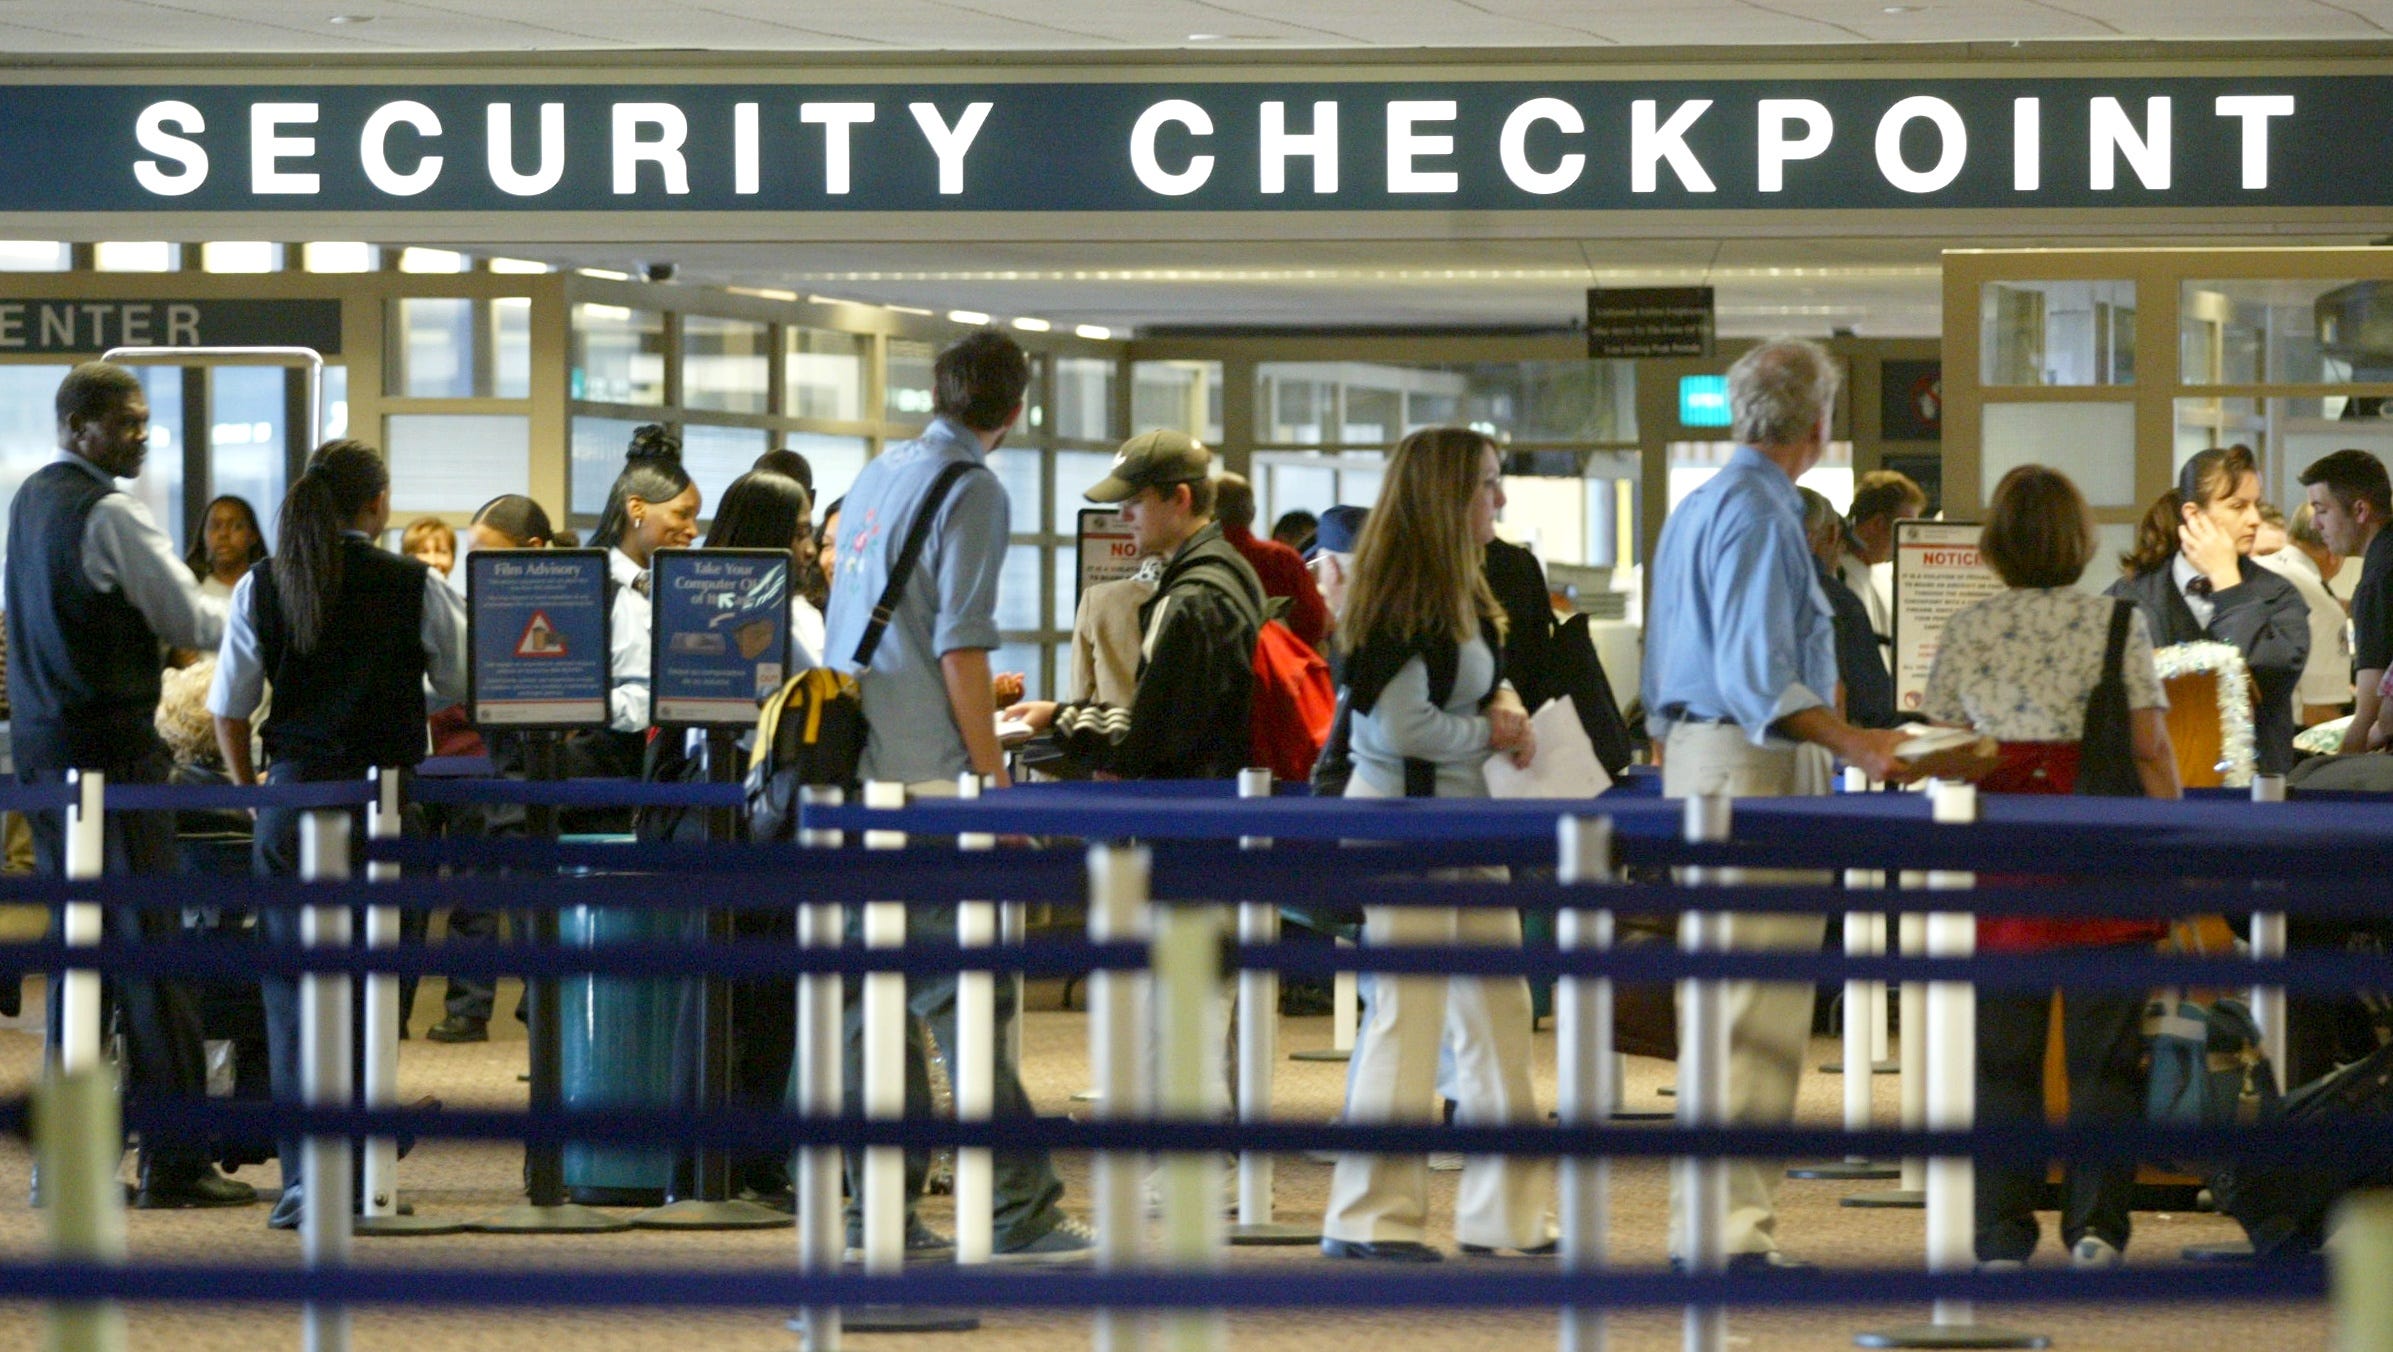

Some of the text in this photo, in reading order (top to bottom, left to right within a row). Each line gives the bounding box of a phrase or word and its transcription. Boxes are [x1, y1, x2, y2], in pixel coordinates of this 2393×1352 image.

[132, 94, 2295, 197] SECURITY CHECKPOINT
[0, 304, 201, 347] ENTER
[494, 562, 582, 578] Film Advisory
[694, 561, 754, 576] Take Your
[674, 576, 737, 594] Computer
